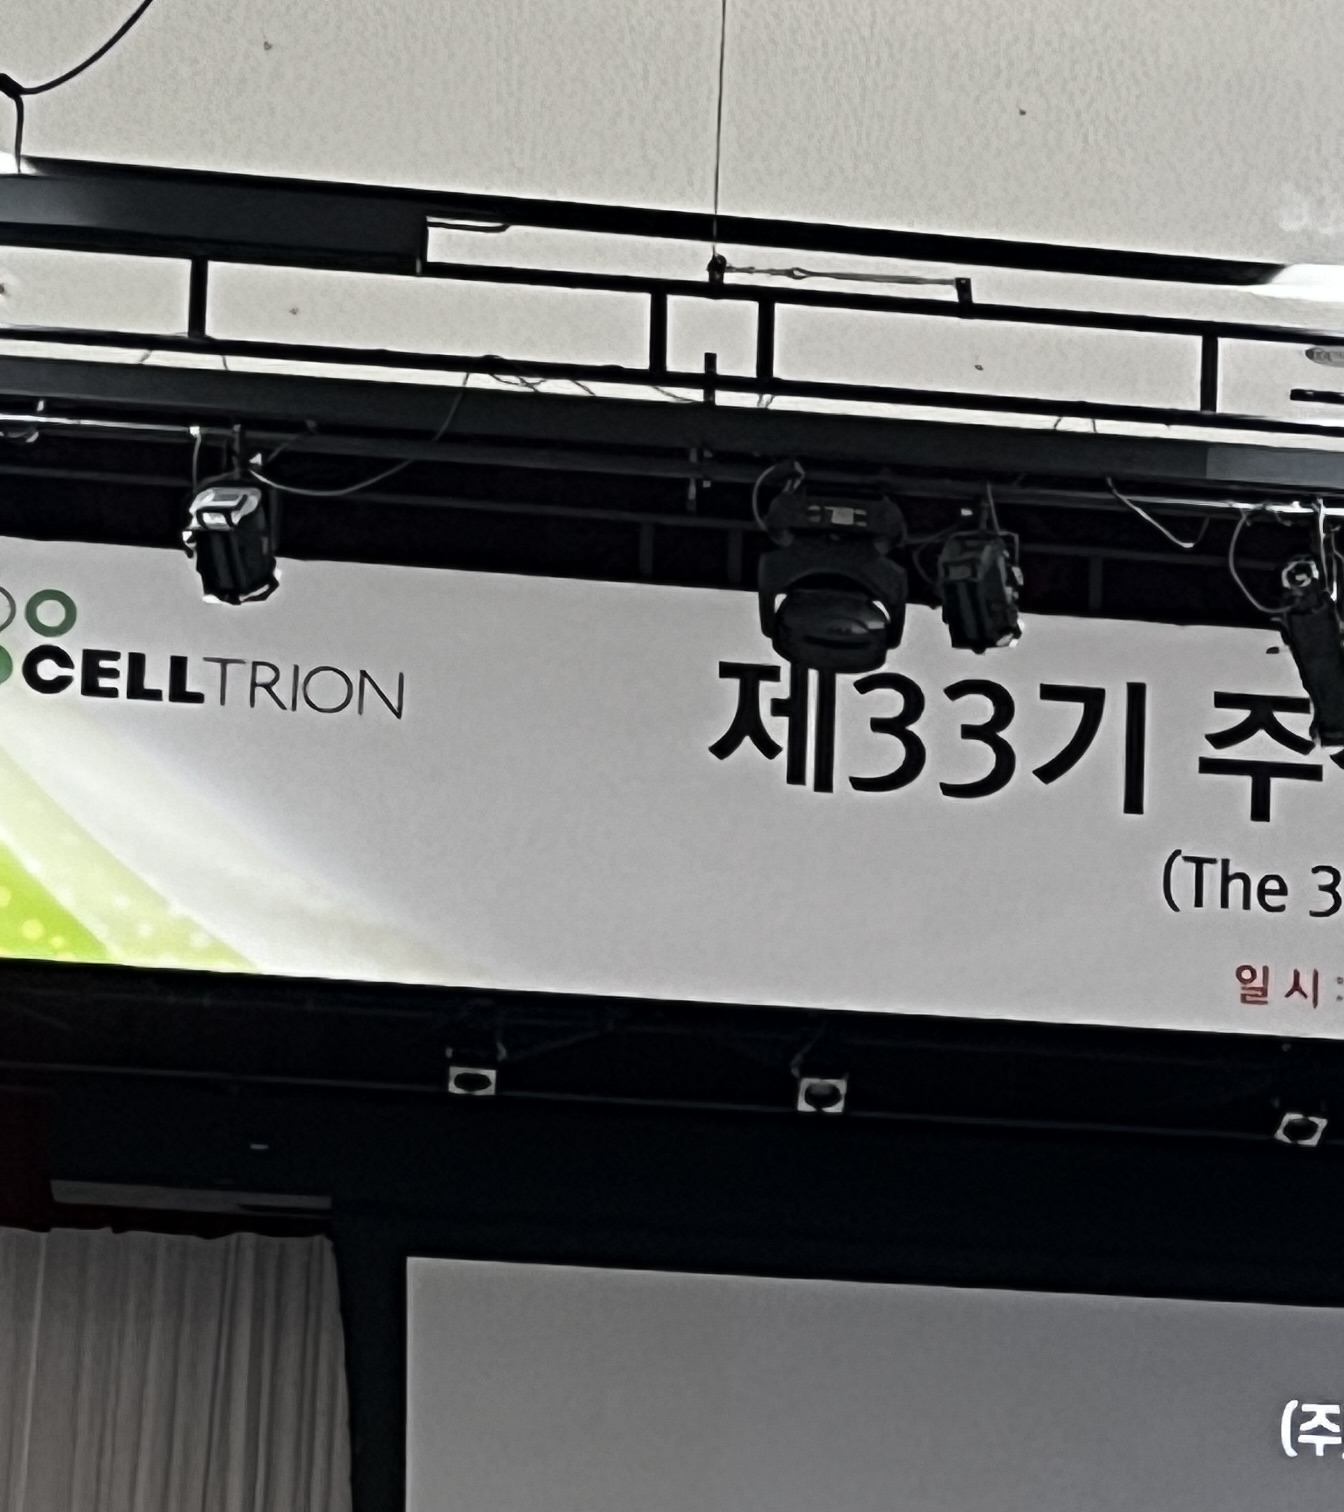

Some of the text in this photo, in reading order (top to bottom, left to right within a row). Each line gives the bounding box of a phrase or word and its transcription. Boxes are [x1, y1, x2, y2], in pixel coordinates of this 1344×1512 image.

[22, 643, 405, 720] CELLTRION
[707, 660, 1147, 816] 제33기
[1162, 848, 1289, 913] (The
